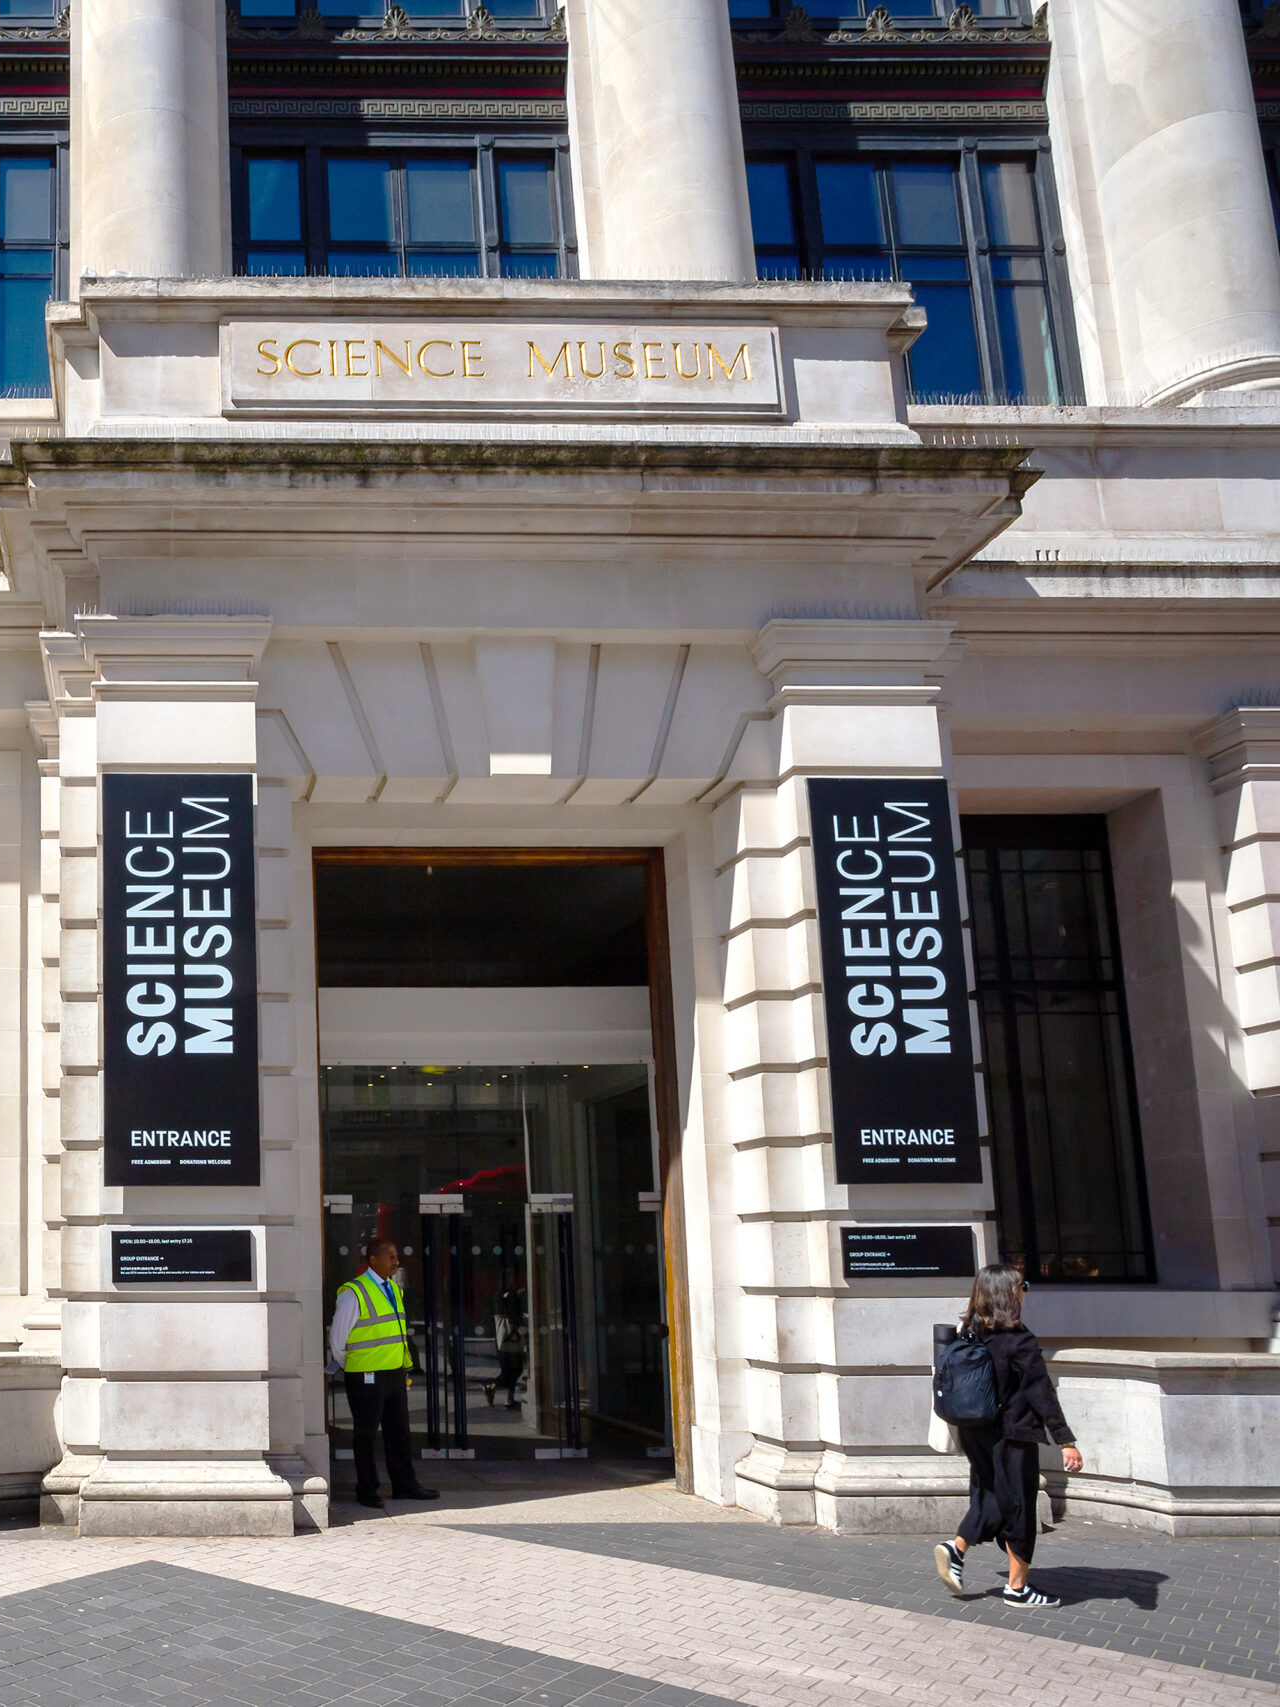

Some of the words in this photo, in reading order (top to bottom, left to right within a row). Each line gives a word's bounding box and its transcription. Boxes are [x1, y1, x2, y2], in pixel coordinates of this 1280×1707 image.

[256, 338, 488, 379] SCIENCE
[527, 340, 753, 382] MUSEUM
[125, 810, 177, 1057] SCIENCE
[181, 797, 234, 1054] MUSEUM
[832, 815, 898, 1057] SCIENCE
[883, 802, 952, 1054] MUSEUM
[130, 1130, 231, 1147] ENTRANCE
[860, 1129, 955, 1146] ENTRANCE
